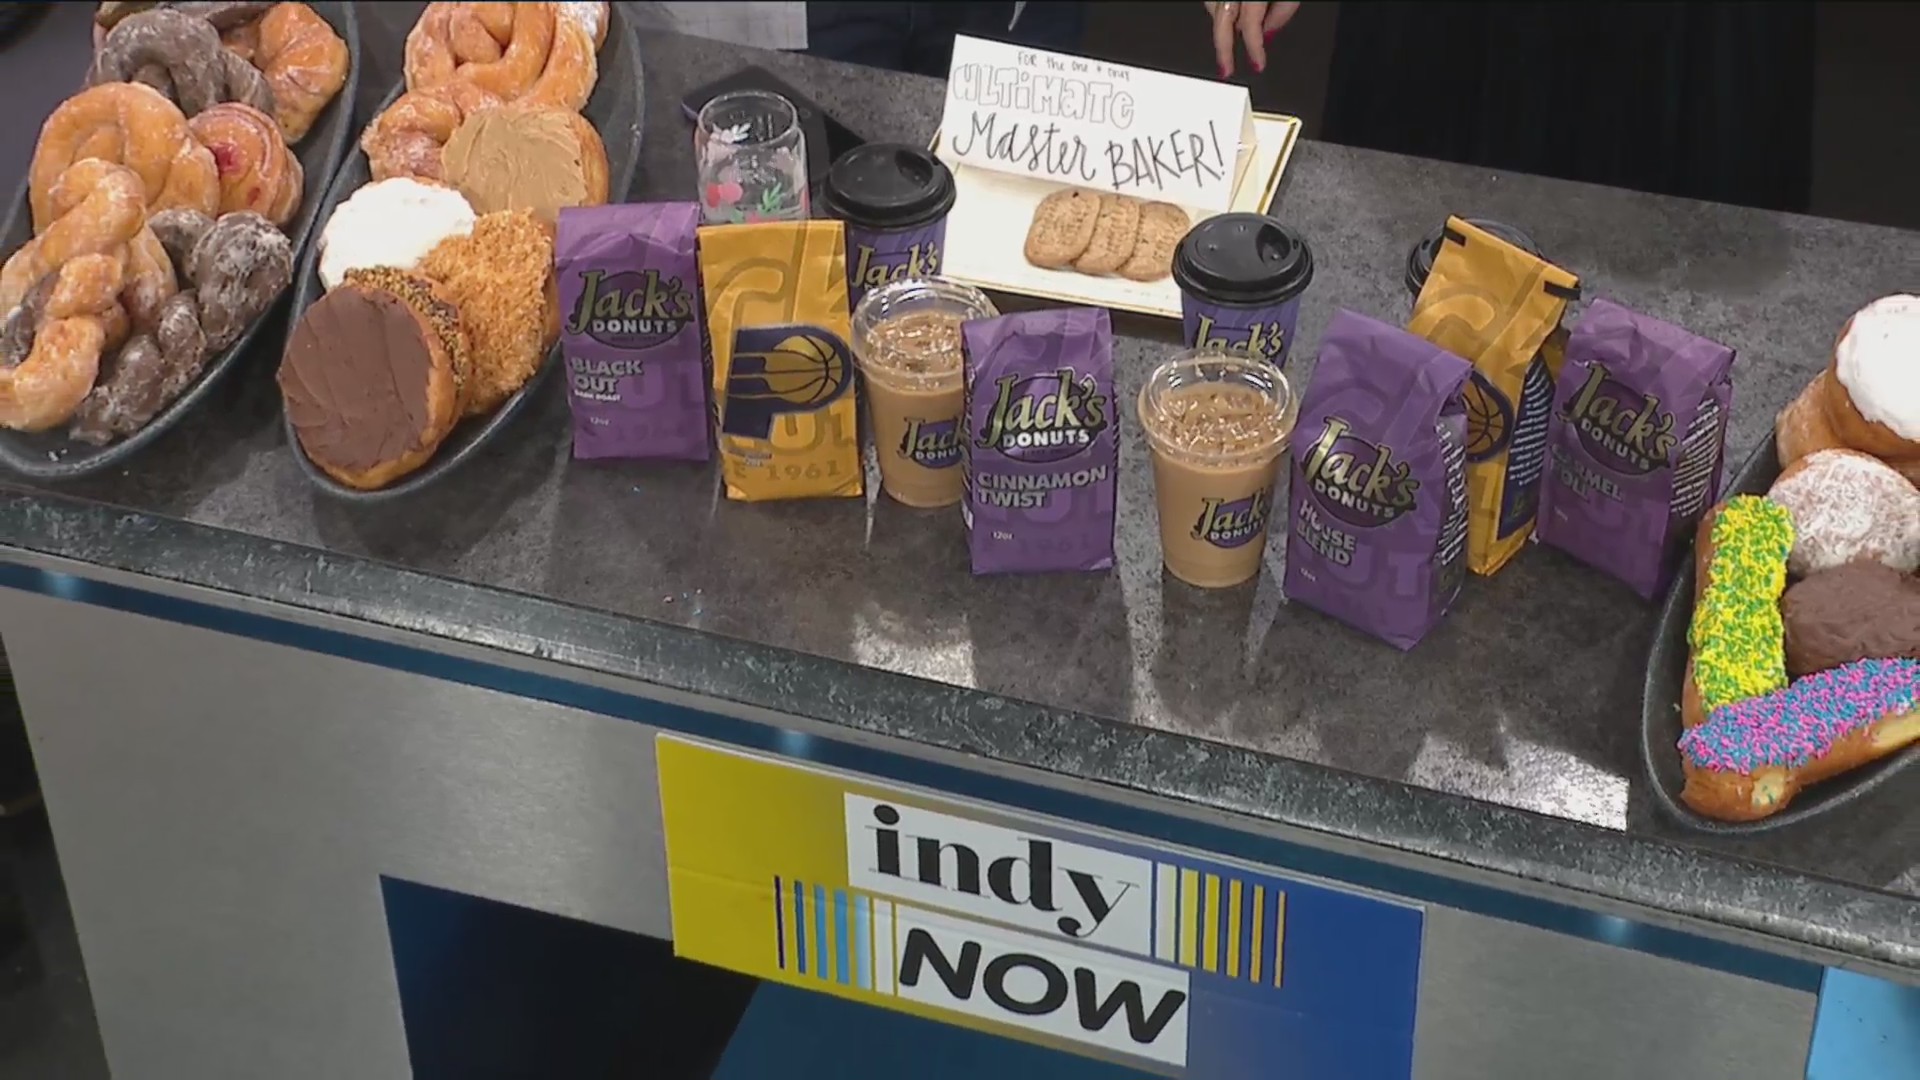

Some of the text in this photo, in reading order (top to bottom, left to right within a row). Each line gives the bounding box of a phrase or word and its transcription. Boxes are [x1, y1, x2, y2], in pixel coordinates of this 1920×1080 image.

[952, 109, 1226, 191] Master BAKER!
[567, 269, 694, 335] Jack's
[592, 318, 678, 334] DONUTS
[571, 357, 643, 376] BLACK
[574, 375, 618, 393] OUT
[975, 367, 1107, 449] Jack's
[1556, 361, 1679, 461] Jack's
[1002, 429, 1090, 448] DONUTS
[1301, 416, 1420, 505] Jack's
[1580, 419, 1651, 470] DONUTS
[766, 459, 841, 480] 1961
[977, 464, 1108, 490] CINNAMON
[977, 488, 1046, 508] TWIST
[1314, 477, 1396, 519] DONUTS
[866, 803, 1141, 938] indy
[898, 926, 1187, 1045] NOW
